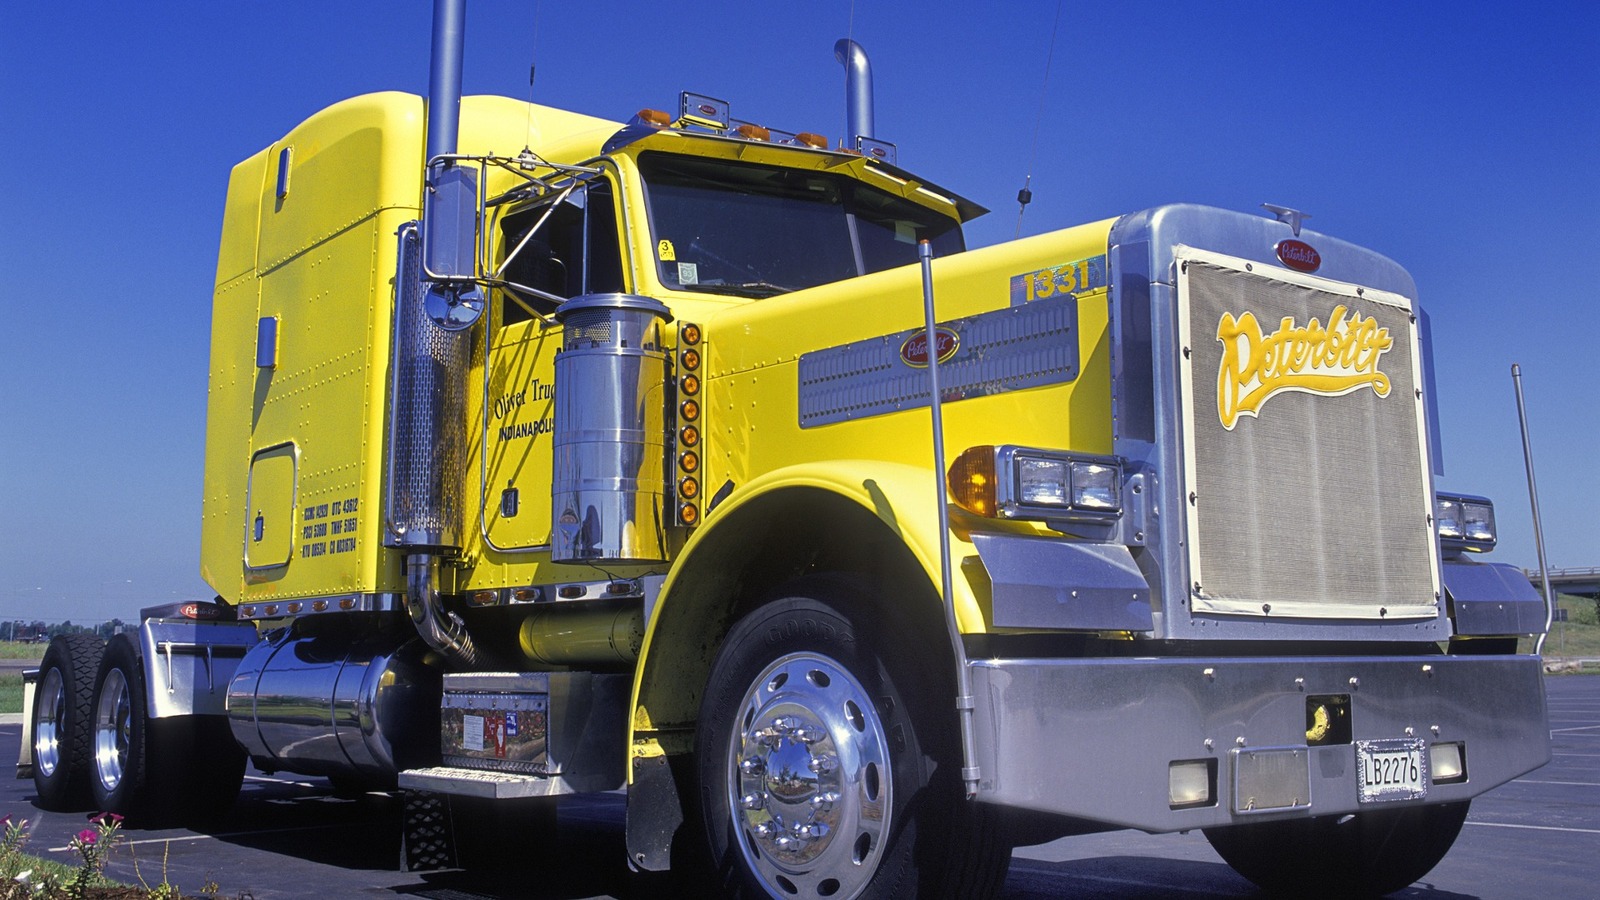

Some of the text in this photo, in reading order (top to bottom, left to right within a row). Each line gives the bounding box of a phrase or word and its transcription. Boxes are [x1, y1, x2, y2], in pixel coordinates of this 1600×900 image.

[661, 241, 669, 251] 3
[1281, 242, 1317, 264] Peterbilt
[1023, 260, 1089, 301] 1331
[907, 336, 950, 358] Peterlt
[494, 389, 526, 420] Oliver
[1364, 757, 1418, 786] LB2276
